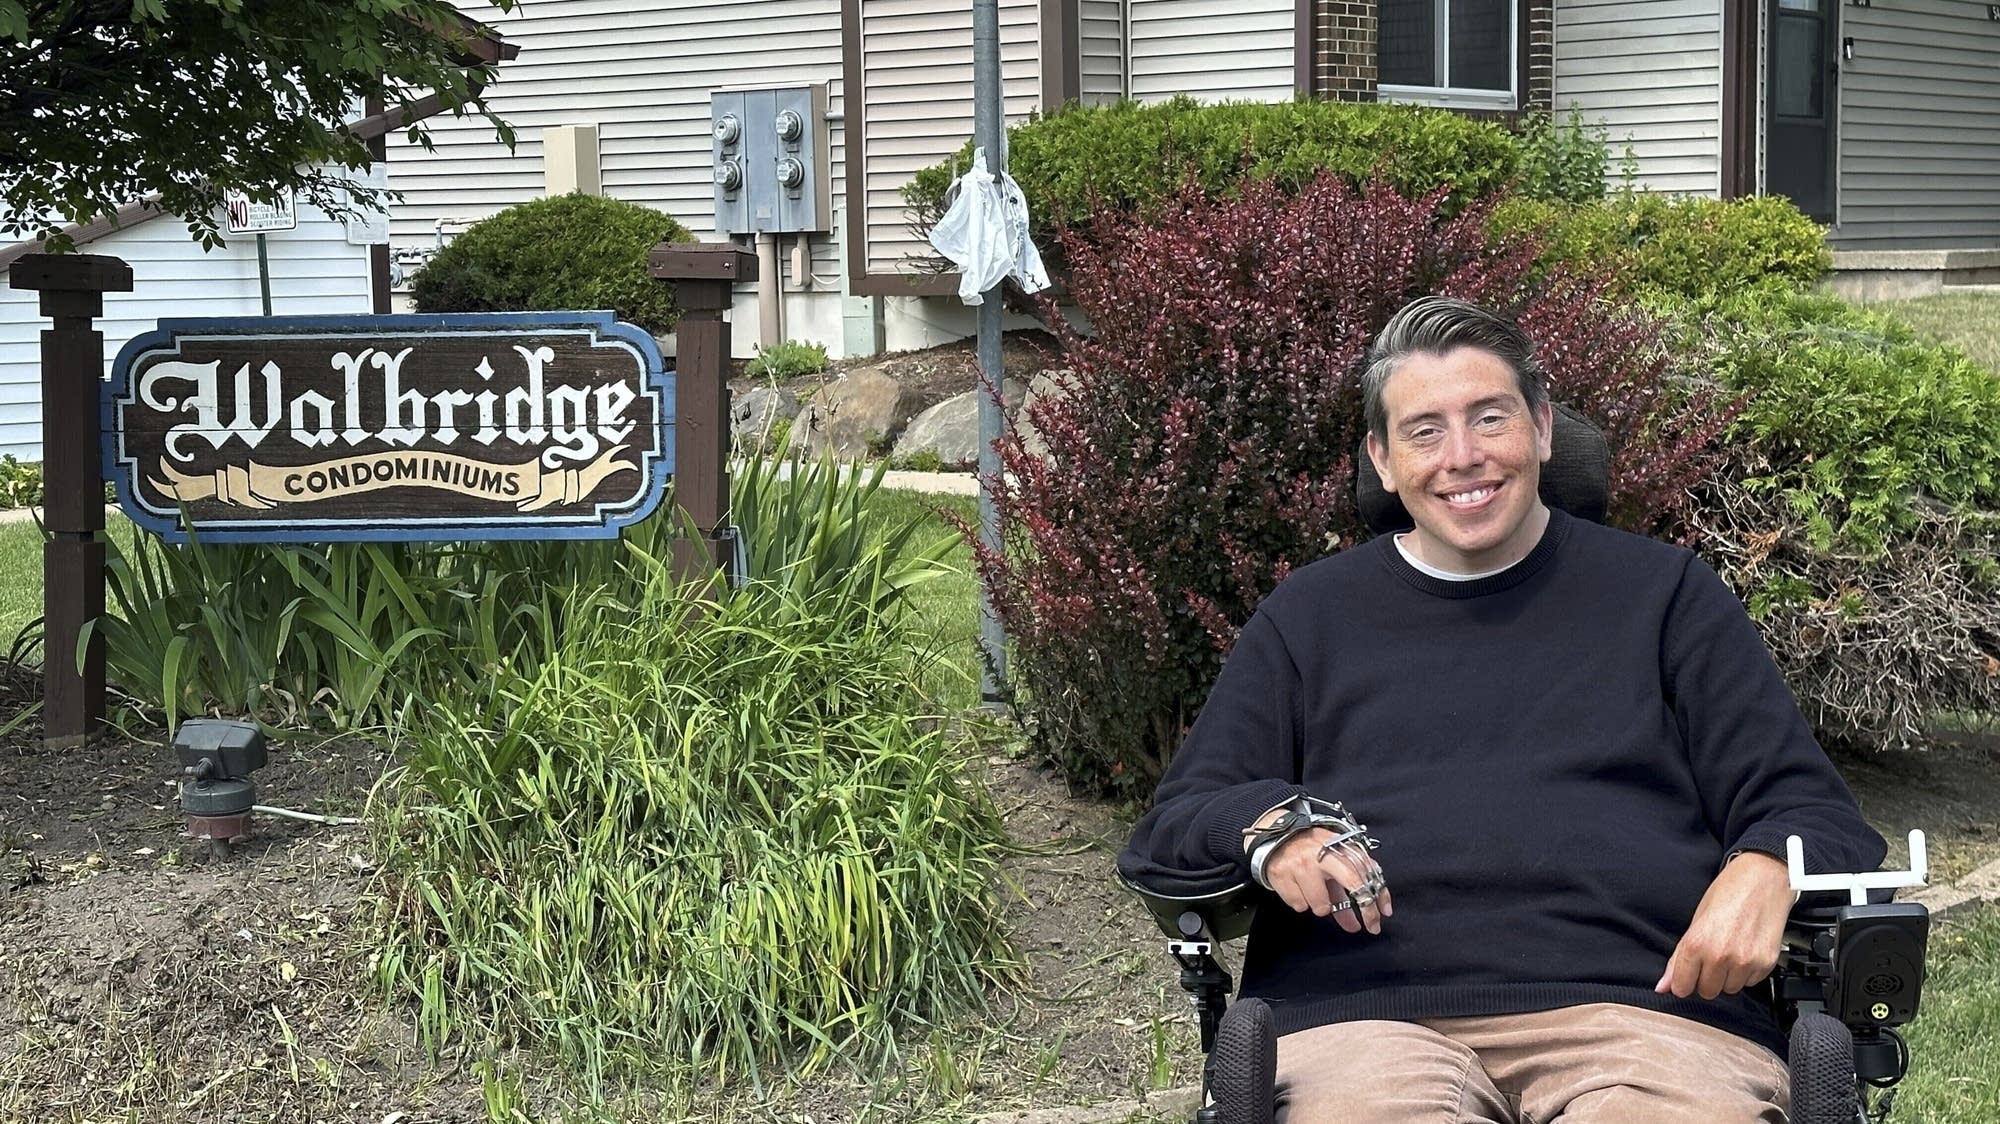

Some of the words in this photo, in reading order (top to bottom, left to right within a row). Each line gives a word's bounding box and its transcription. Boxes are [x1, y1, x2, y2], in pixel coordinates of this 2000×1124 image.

[229, 200, 248, 228] NO
[139, 346, 637, 469] Walbridge
[284, 457, 520, 496] CONDOMINIUMS
